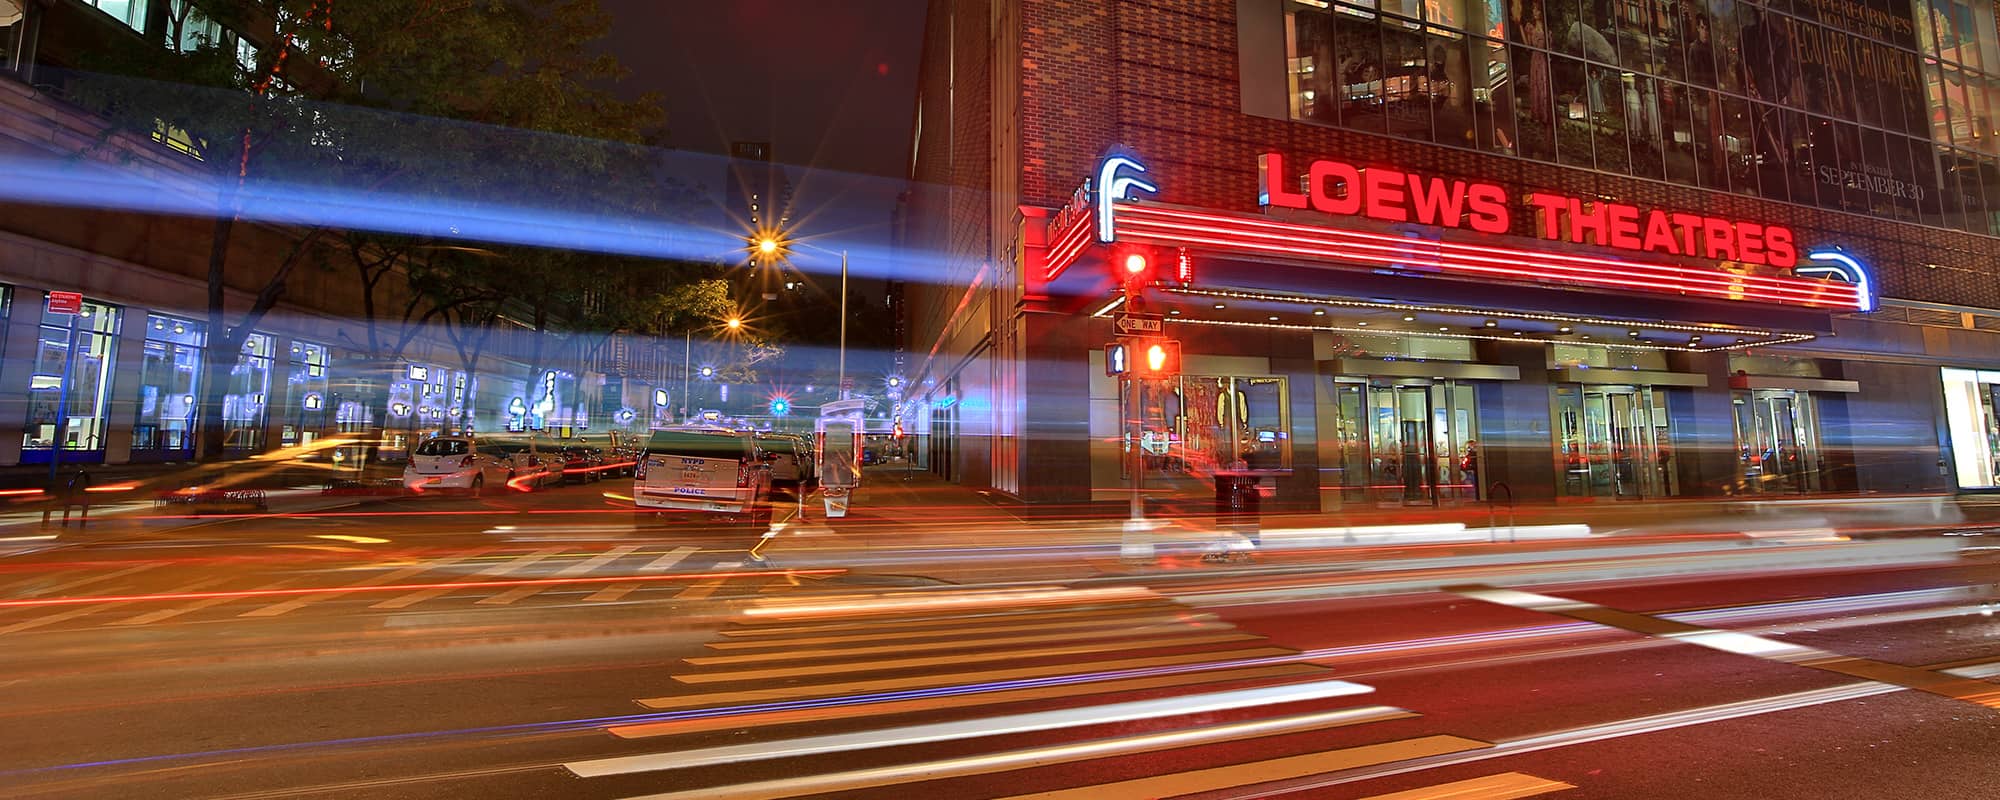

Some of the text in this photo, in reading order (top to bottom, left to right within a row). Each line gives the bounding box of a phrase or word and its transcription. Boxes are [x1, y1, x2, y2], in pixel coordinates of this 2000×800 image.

[1820, 164, 1924, 200] SEPTEMBER 30
[1267, 153, 1797, 268] LOEWS THEATRES
[1121, 320, 1158, 330] ONE WAY
[674, 487, 706, 495] POLICE
